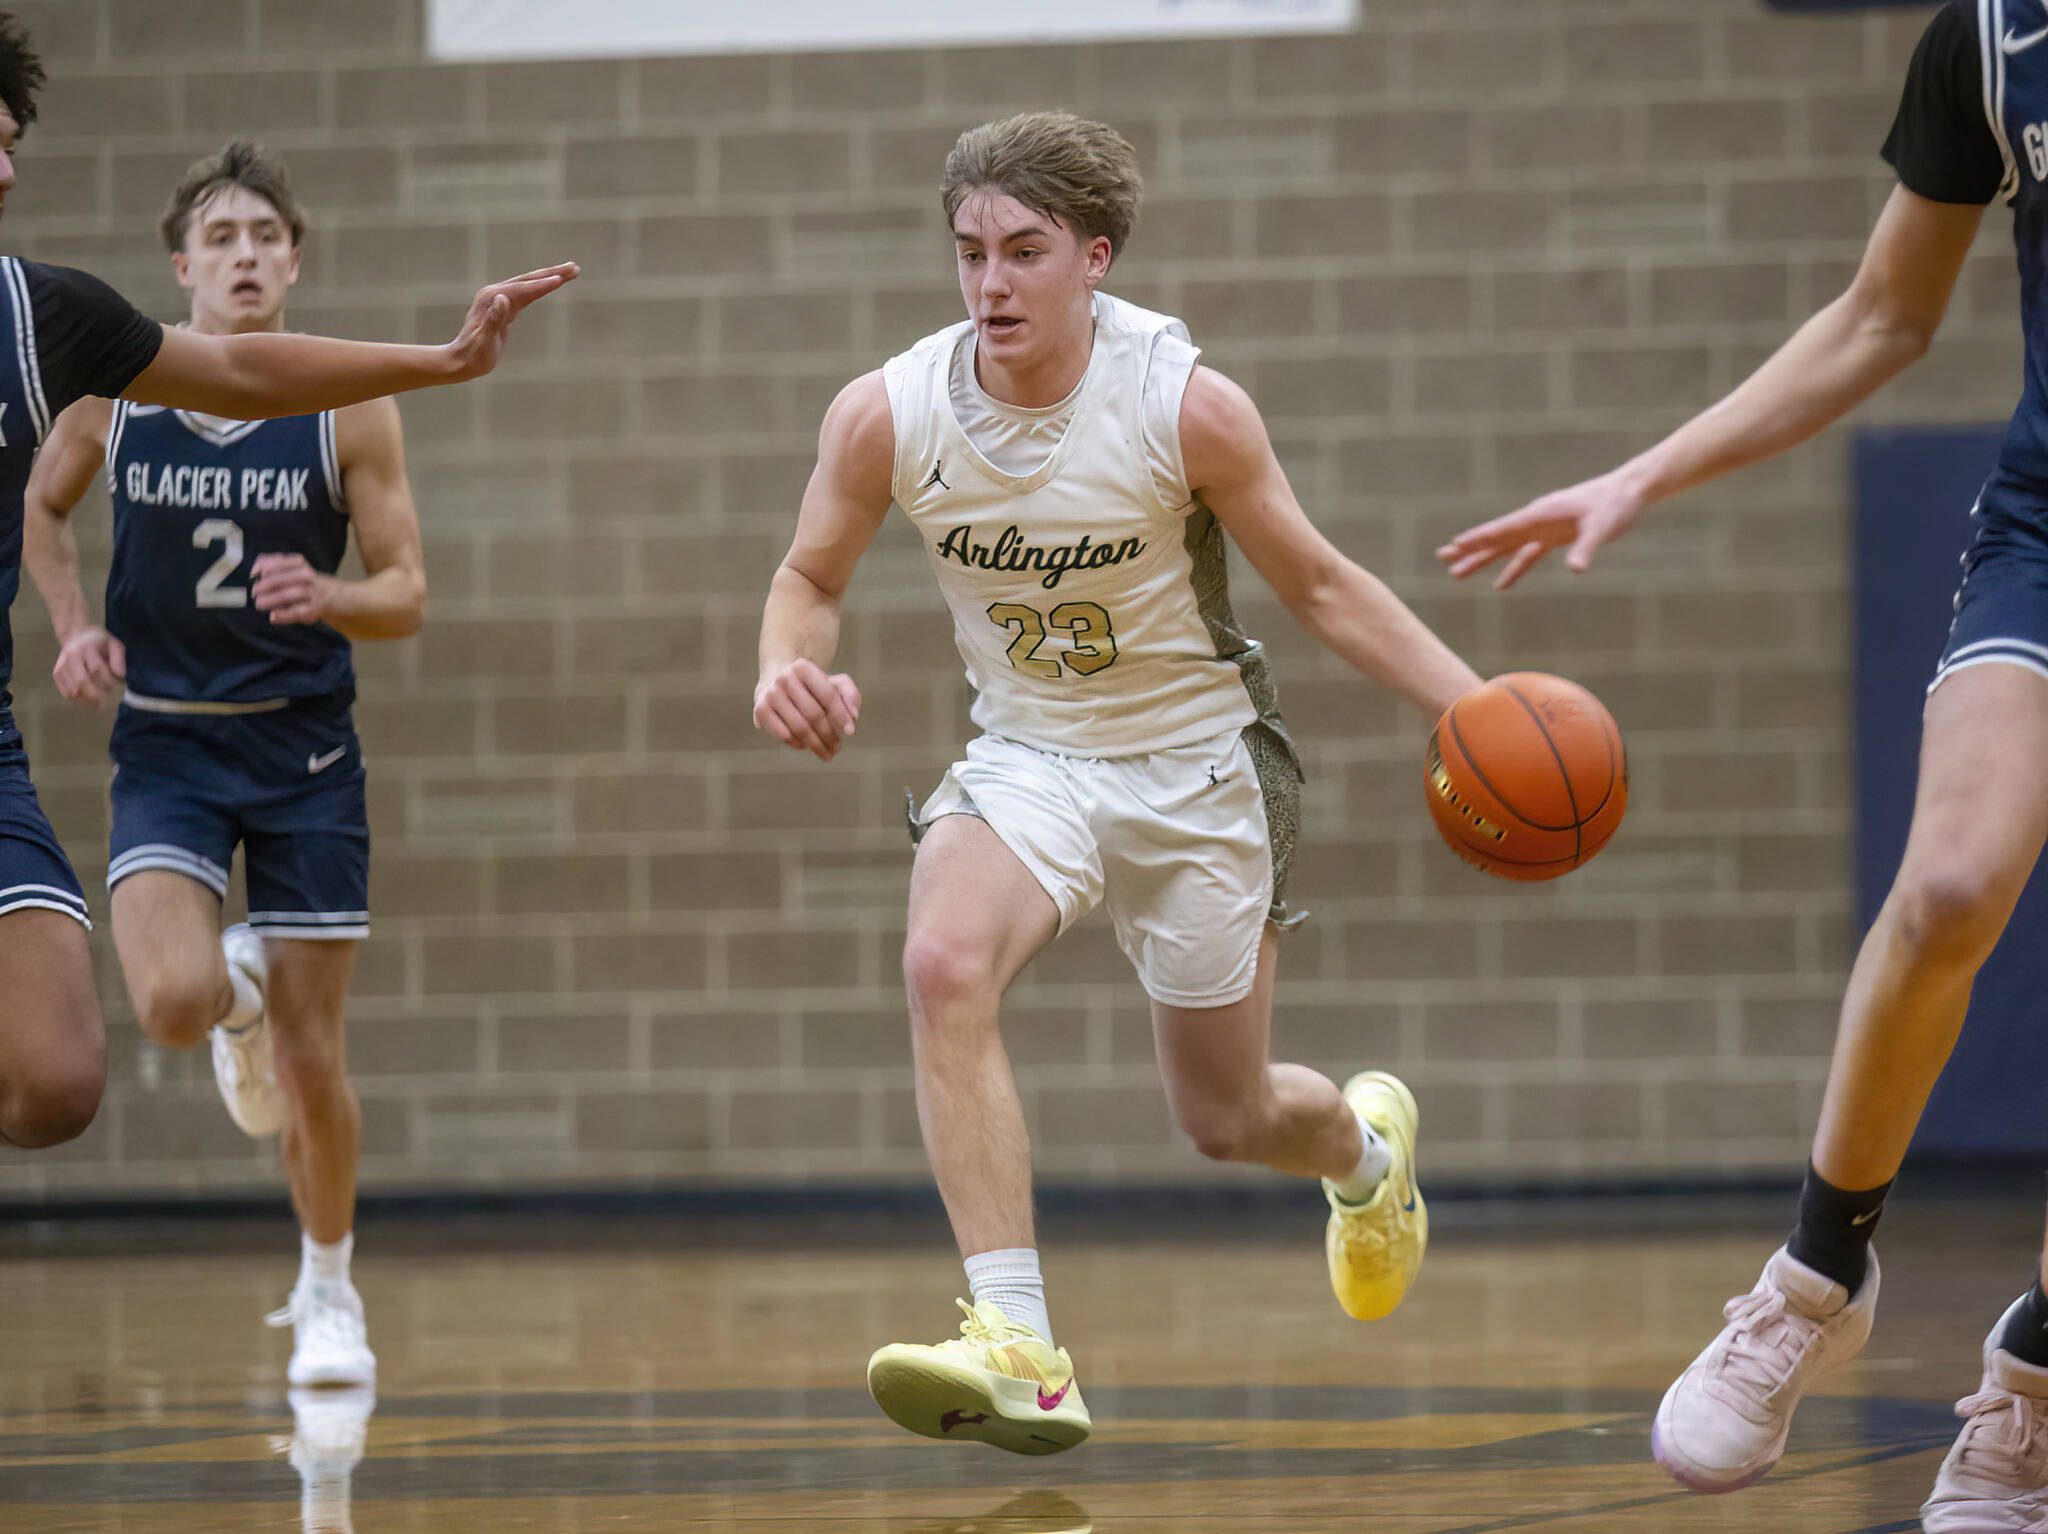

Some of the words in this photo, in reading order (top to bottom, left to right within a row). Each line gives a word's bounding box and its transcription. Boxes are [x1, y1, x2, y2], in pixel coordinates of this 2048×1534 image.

[126, 462, 232, 509] GLACIER
[240, 468, 310, 511] PEAK
[192, 518, 247, 608] 2
[936, 525, 1147, 589] Arlington
[986, 602, 1120, 679] 23
